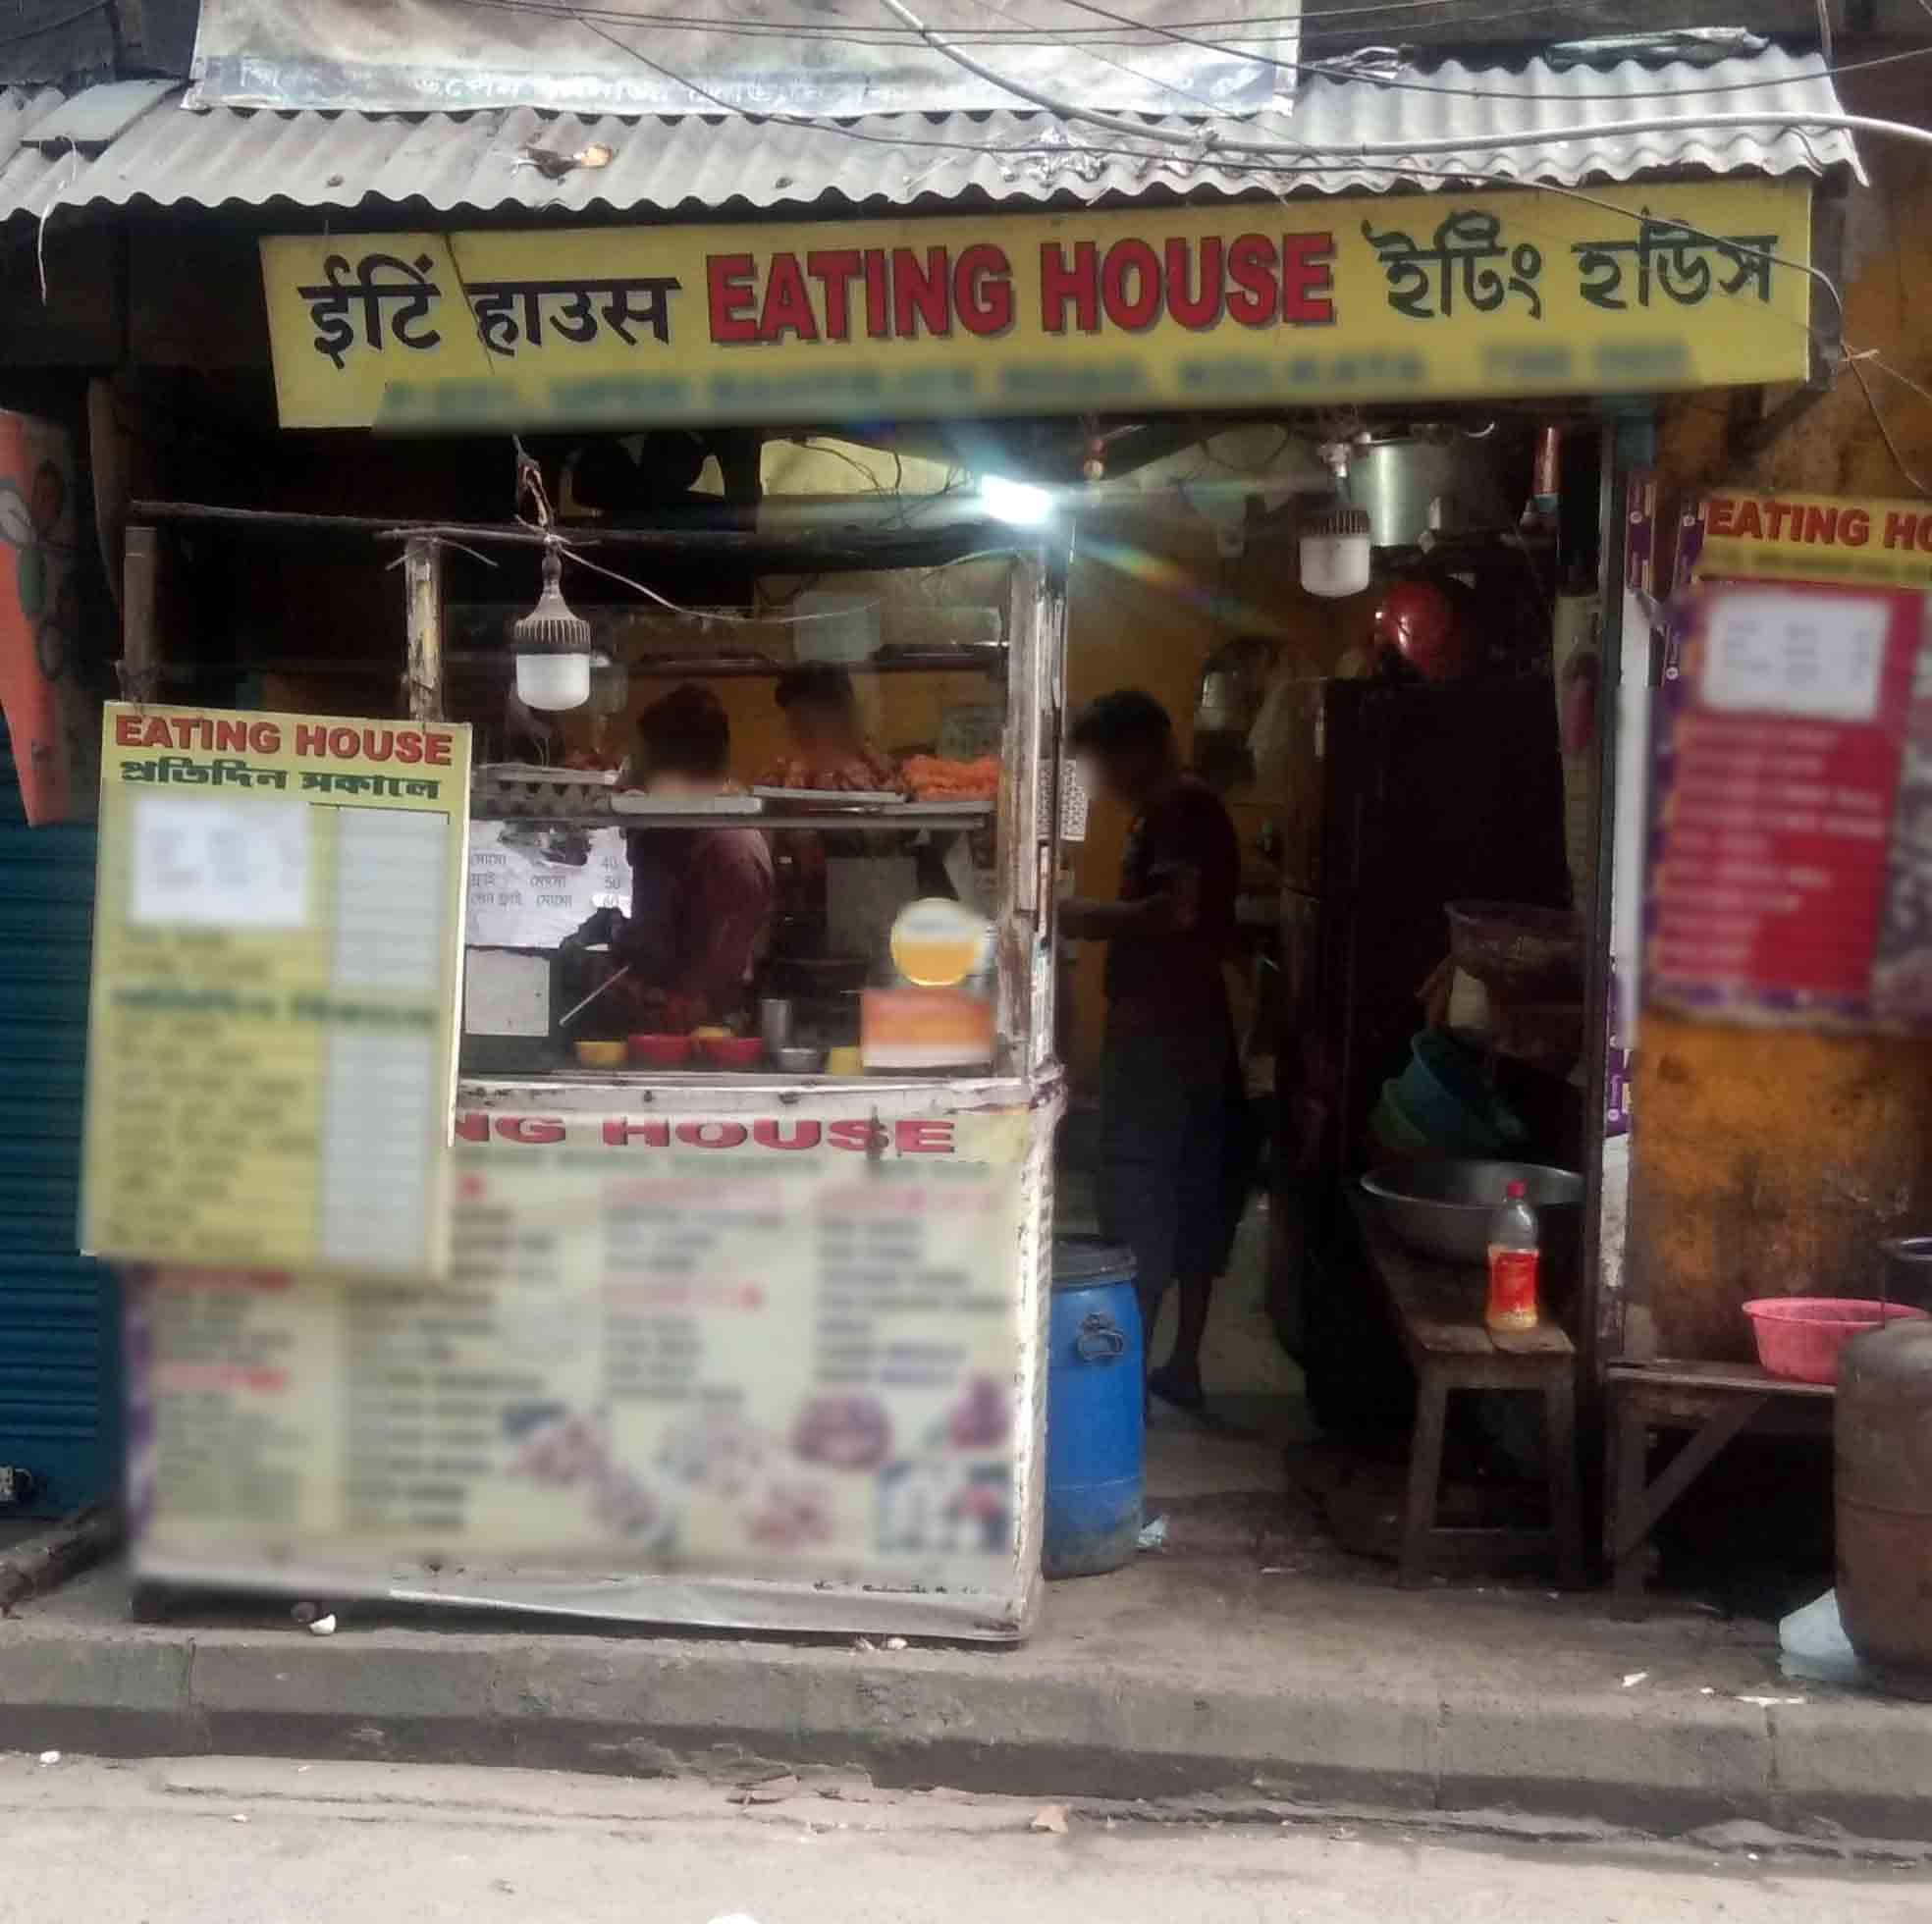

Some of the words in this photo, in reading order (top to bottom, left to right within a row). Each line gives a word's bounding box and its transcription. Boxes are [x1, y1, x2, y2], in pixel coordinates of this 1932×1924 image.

[705, 242, 1014, 344] EATING
[1039, 231, 1336, 335] HOUSE
[1361, 209, 1541, 321] ইটিং
[463, 277, 682, 357] हाउस
[1704, 498, 1870, 547] EATING
[115, 714, 281, 754] EATING
[295, 722, 455, 766] HOUSE
[120, 756, 289, 789] প্রতিদিন
[298, 771, 442, 799] সকালে
[602, 1115, 956, 1154] HOUSE
